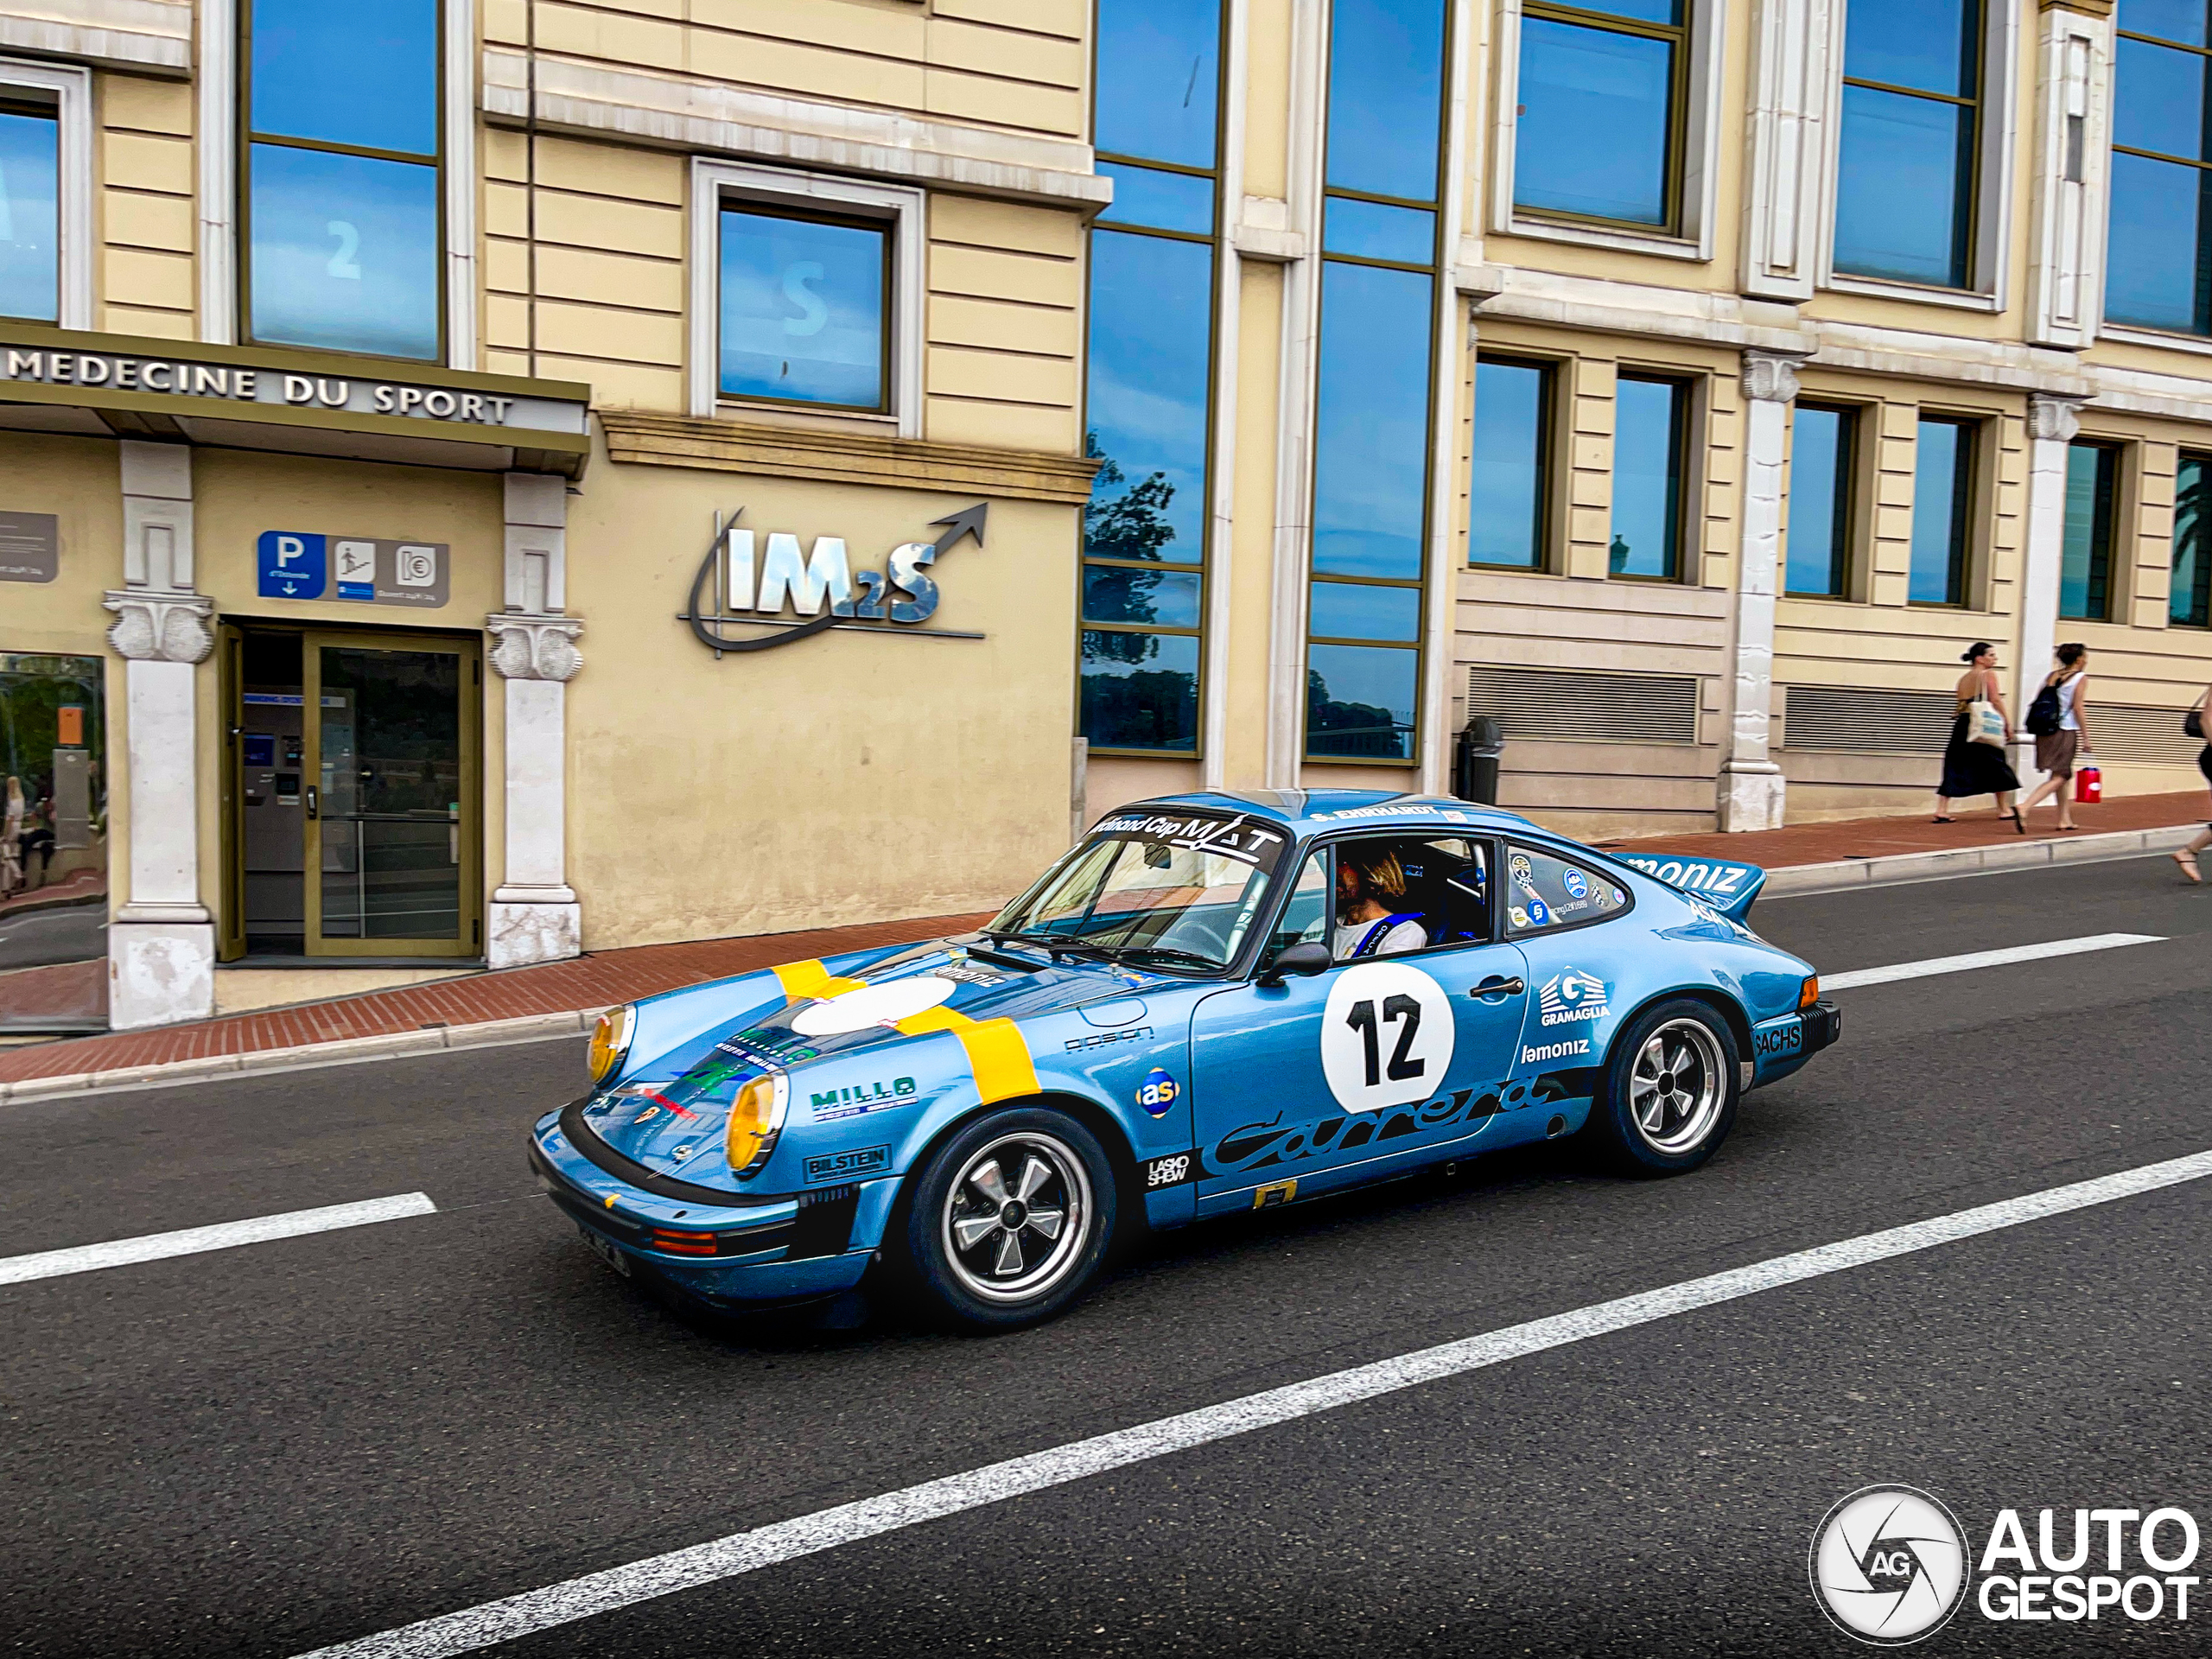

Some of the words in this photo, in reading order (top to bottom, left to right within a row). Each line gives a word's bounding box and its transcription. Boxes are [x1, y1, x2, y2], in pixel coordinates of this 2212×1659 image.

[327, 219, 361, 279] 2
[782, 261, 828, 336] S
[7, 349, 257, 397] MEDECINE
[284, 375, 349, 407] DU
[374, 385, 514, 423] SPORT
[276, 536, 305, 568] P
[728, 528, 940, 623] IM2S
[1143, 817, 1182, 839] Cup
[1541, 1005, 1611, 1027] GRAMAGLIA
[1345, 993, 1426, 1088] 12
[1755, 1025, 1801, 1057] SACHS
[810, 1076, 917, 1111] MILLO
